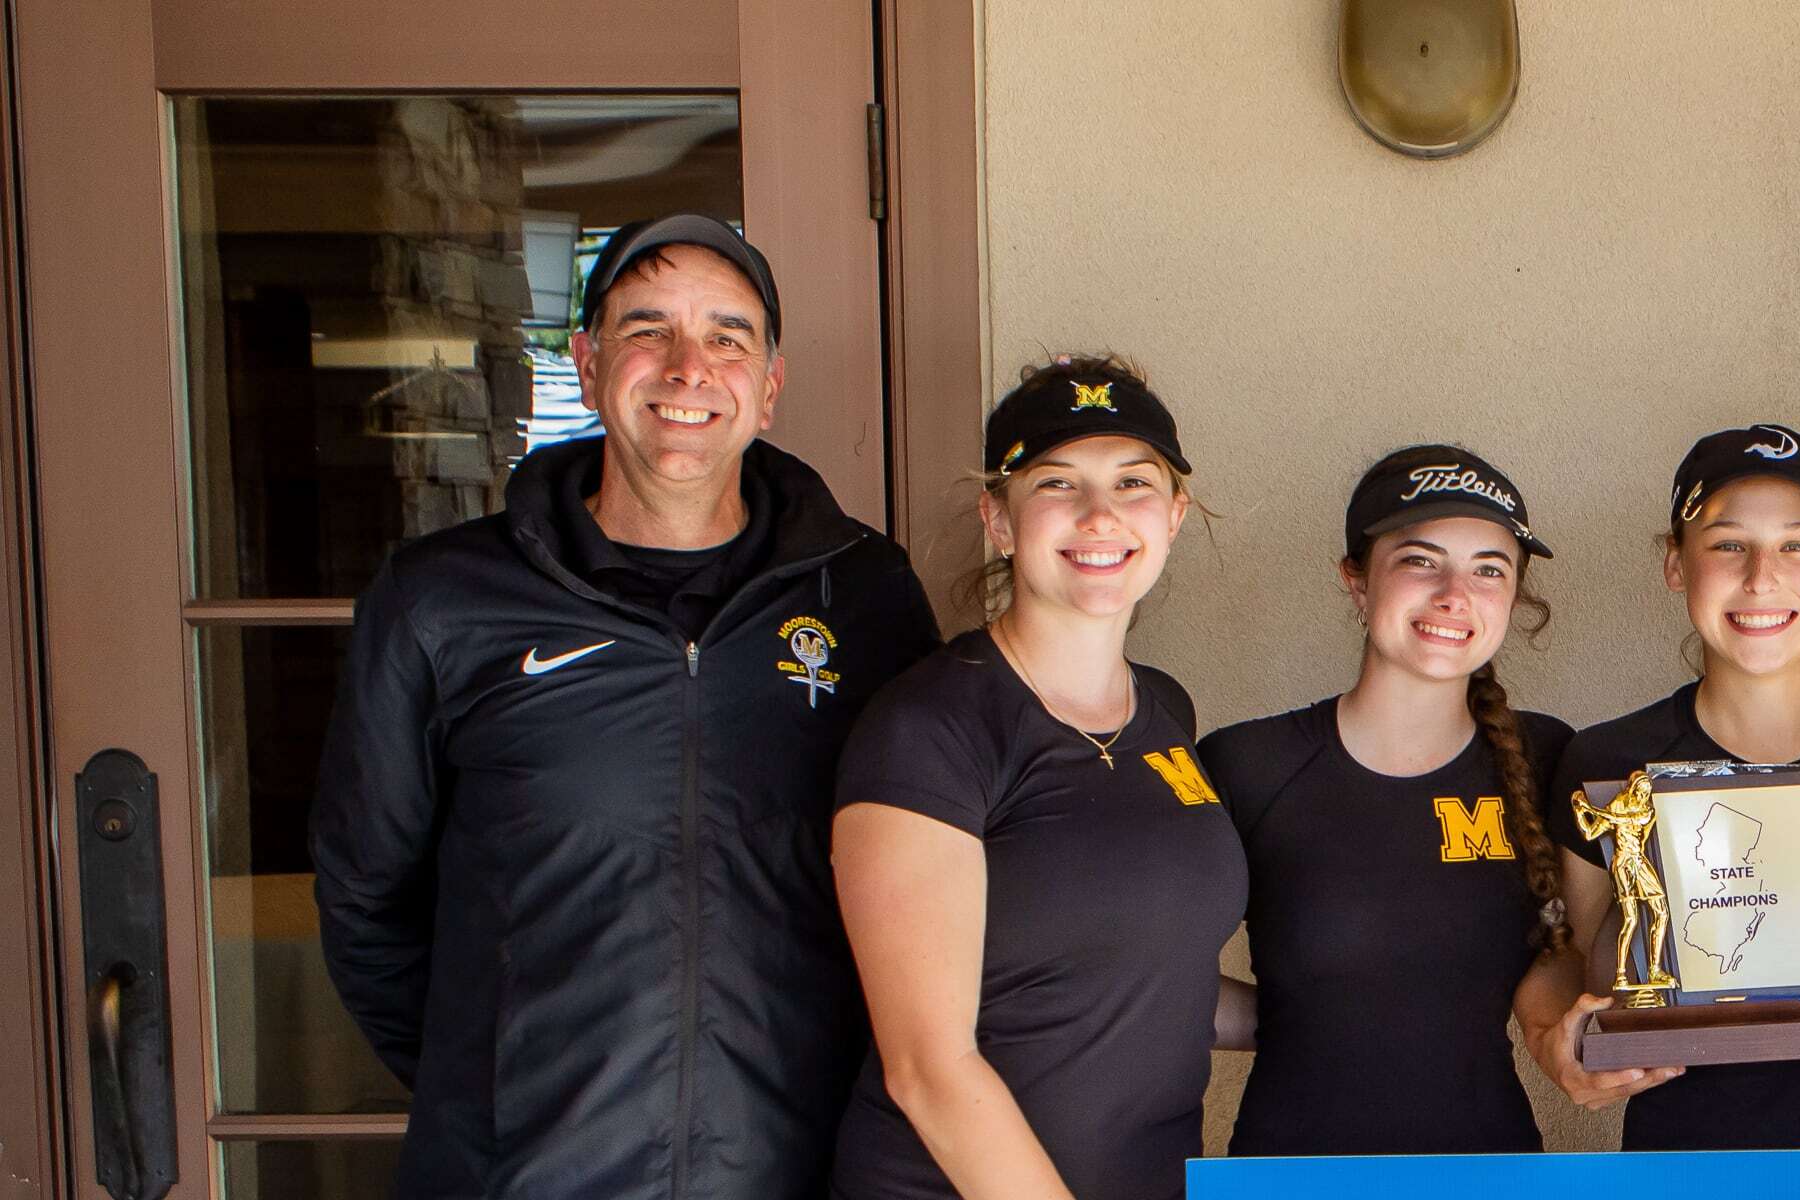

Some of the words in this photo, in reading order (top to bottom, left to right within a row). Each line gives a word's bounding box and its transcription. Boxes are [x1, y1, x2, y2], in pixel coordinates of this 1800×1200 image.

[1077, 385, 1111, 407] M
[1401, 464, 1516, 511] Titleist
[778, 616, 838, 648] MOORESTOWN
[777, 661, 806, 674] GIRLS
[818, 669, 841, 682] GOLF
[1143, 747, 1220, 806] M
[1433, 797, 1516, 862] M
[1710, 866, 1755, 880] STATE
[1688, 893, 1778, 910] CHAMPIONS
